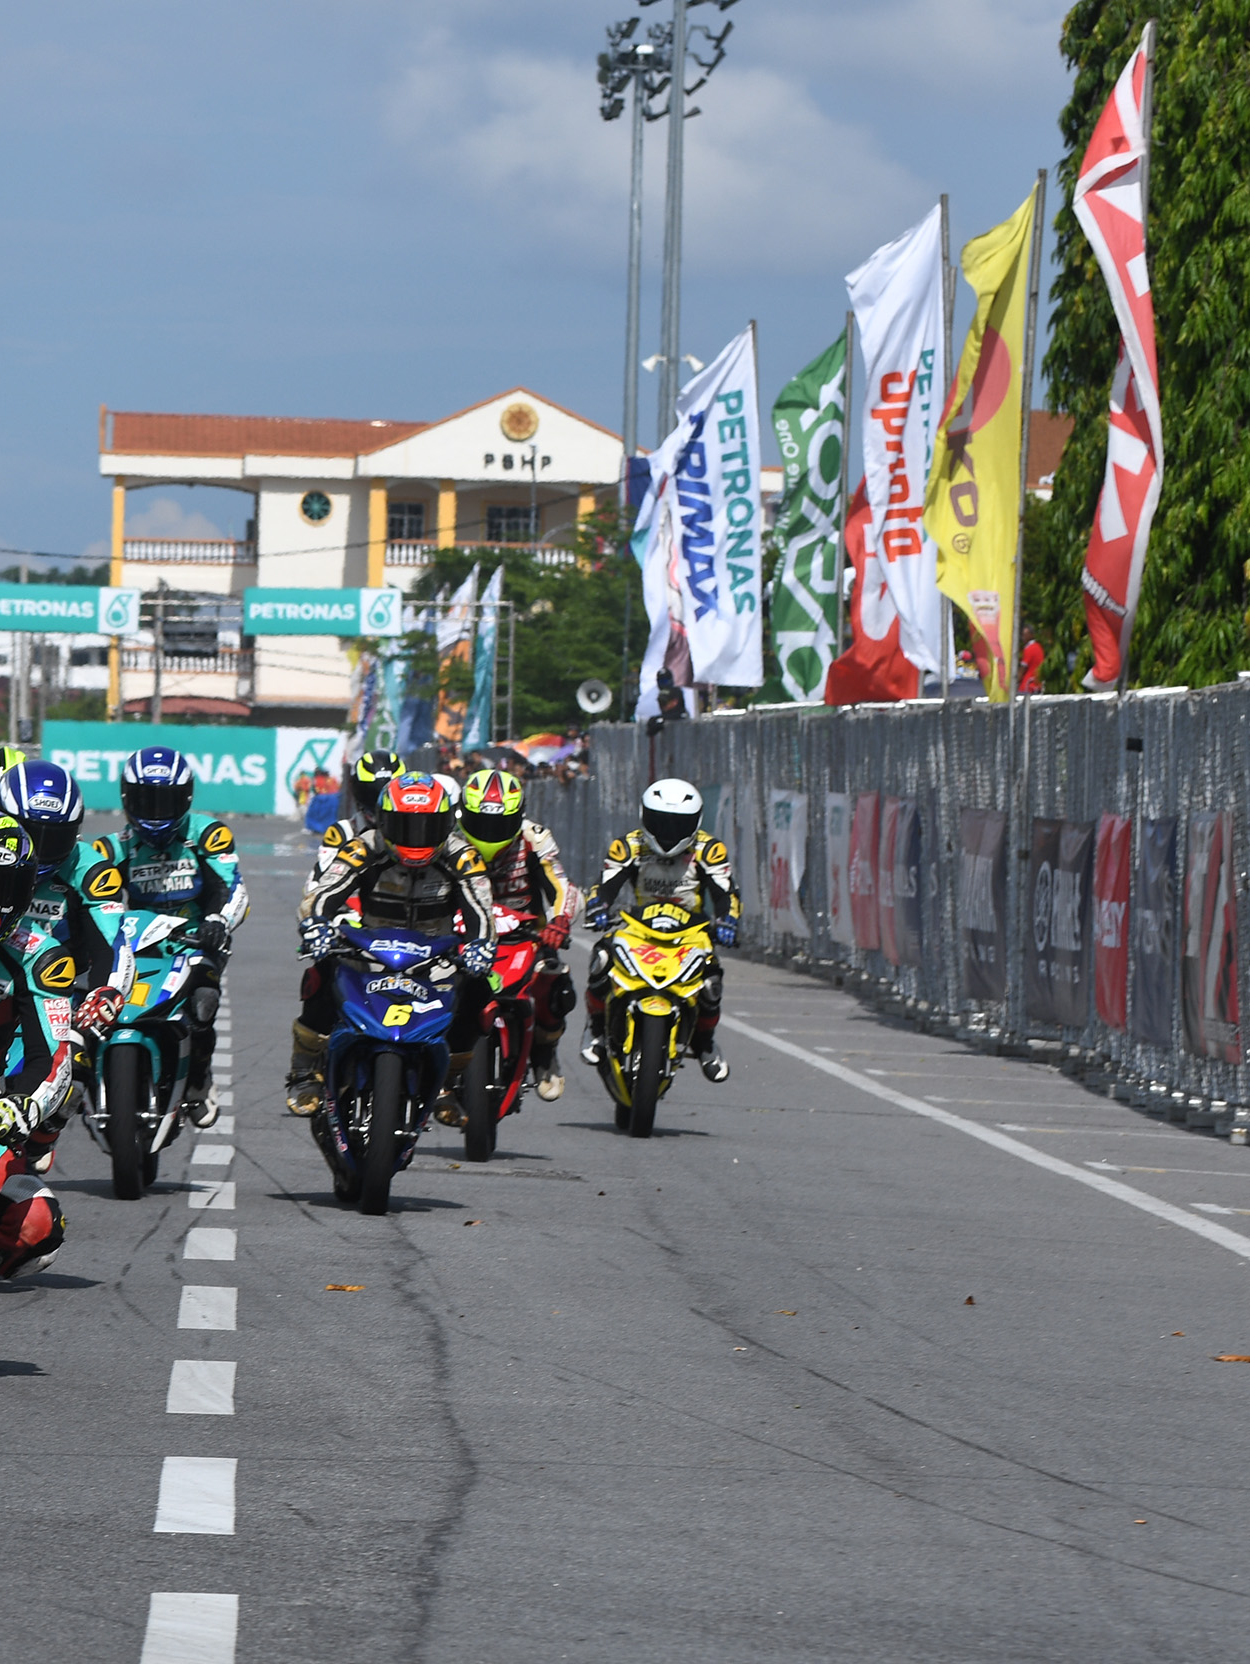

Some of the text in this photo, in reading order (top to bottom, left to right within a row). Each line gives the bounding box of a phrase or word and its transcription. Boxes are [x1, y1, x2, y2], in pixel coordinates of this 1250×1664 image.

[717, 389, 755, 616] PETRONAS
[249, 600, 356, 622] PETRONAS
[51, 749, 267, 787] PETNAS
[34, 798, 60, 808] SHOEI
[50, 1014, 70, 1025] RK
[382, 1004, 413, 1026] 6
